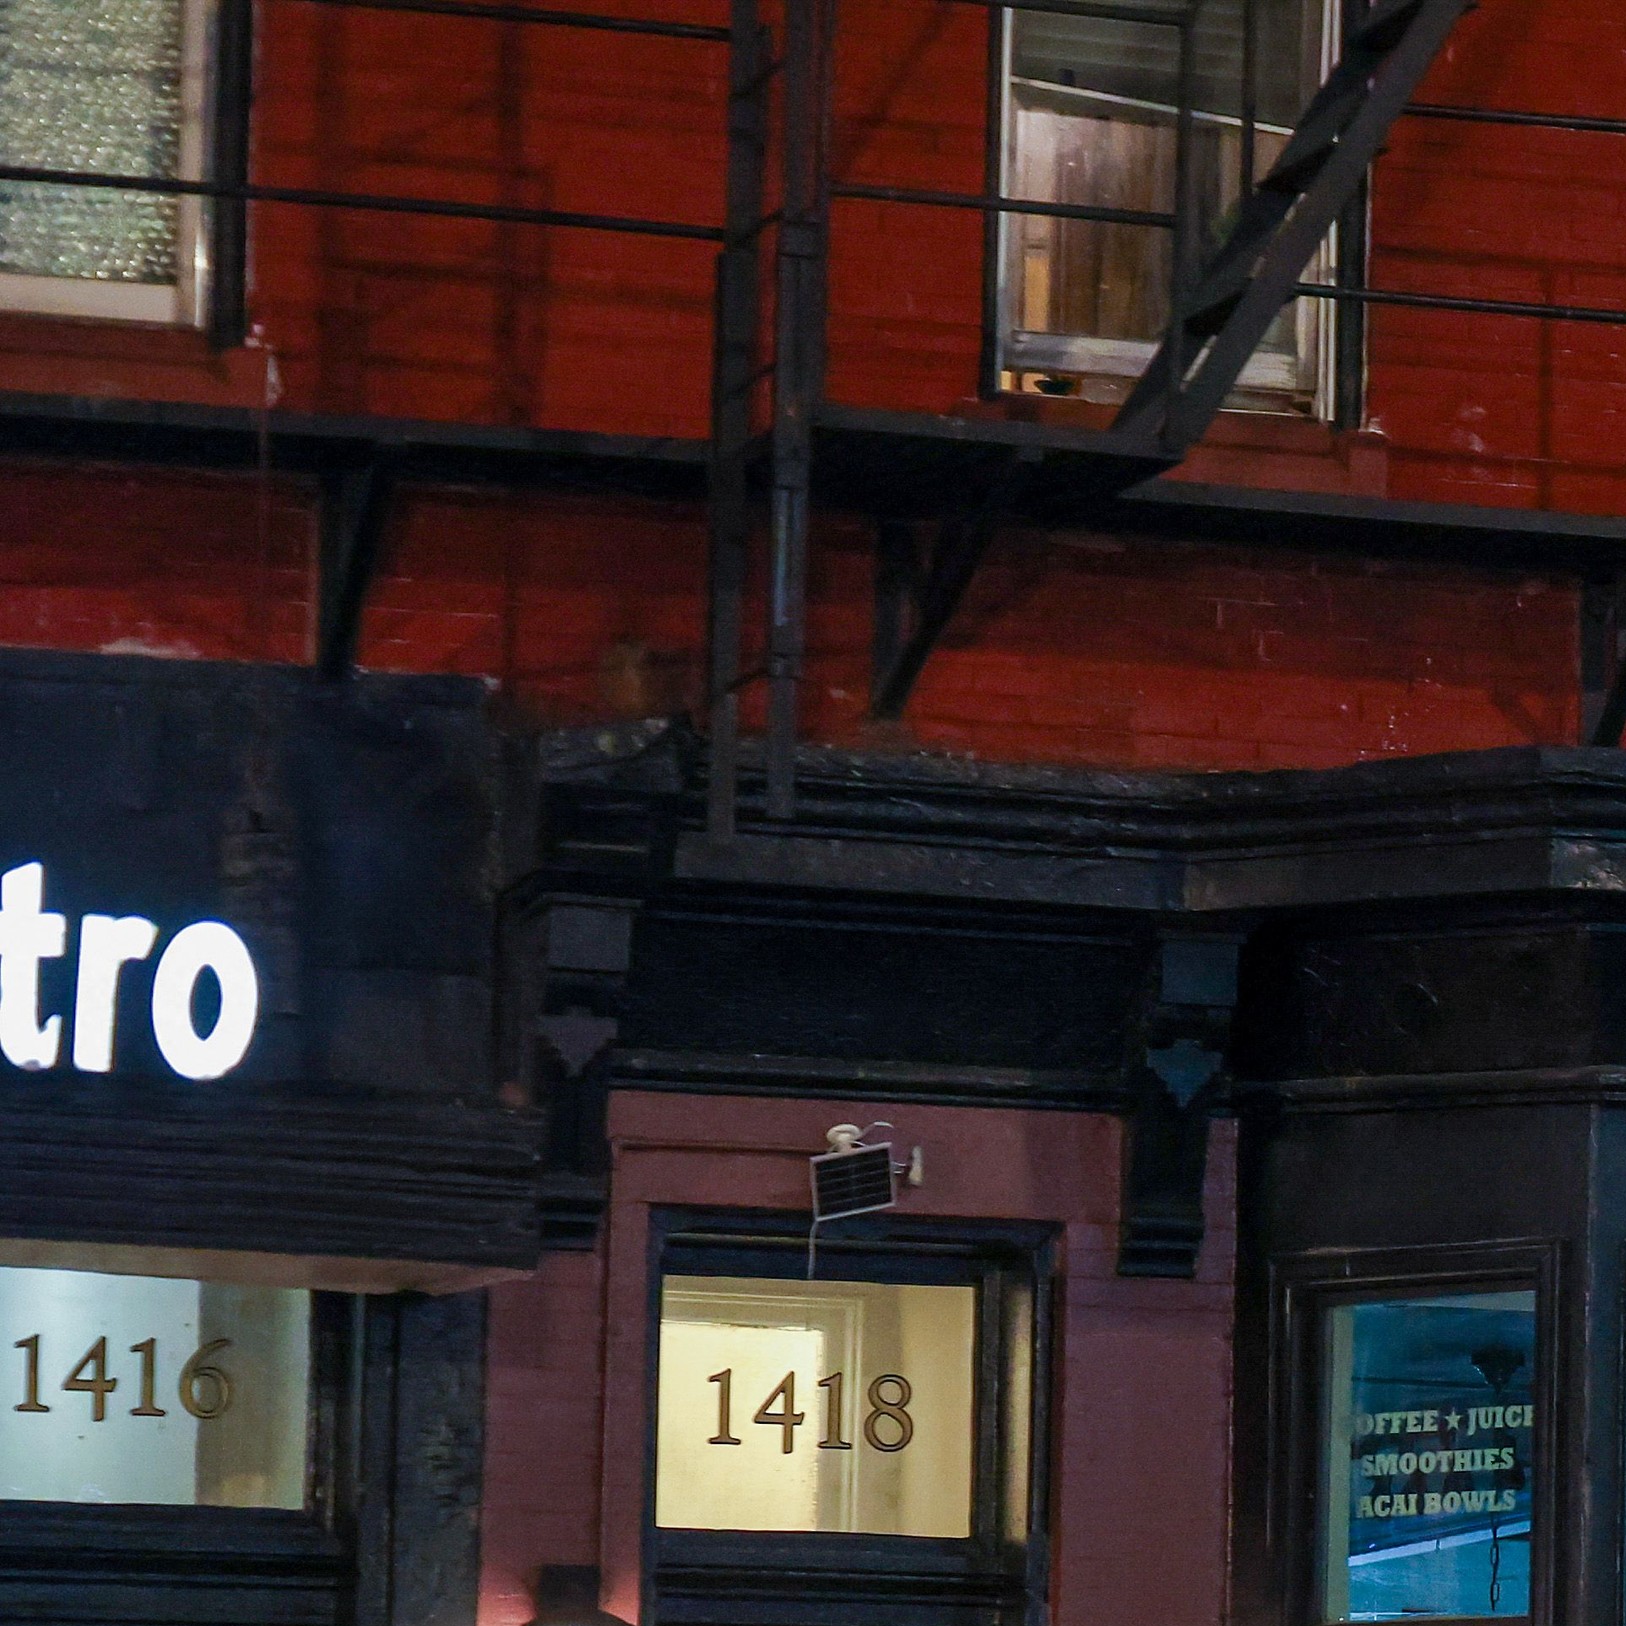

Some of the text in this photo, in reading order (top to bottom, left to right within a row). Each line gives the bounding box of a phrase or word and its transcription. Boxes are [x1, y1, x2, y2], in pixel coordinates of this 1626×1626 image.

[0, 862, 259, 1081] tro
[14, 1334, 234, 1422] 1416
[707, 1368, 914, 1455] 1418
[1357, 1490, 1516, 1519] ACAI BOWLS
[1361, 1447, 1514, 1476] SMOOTHIES
